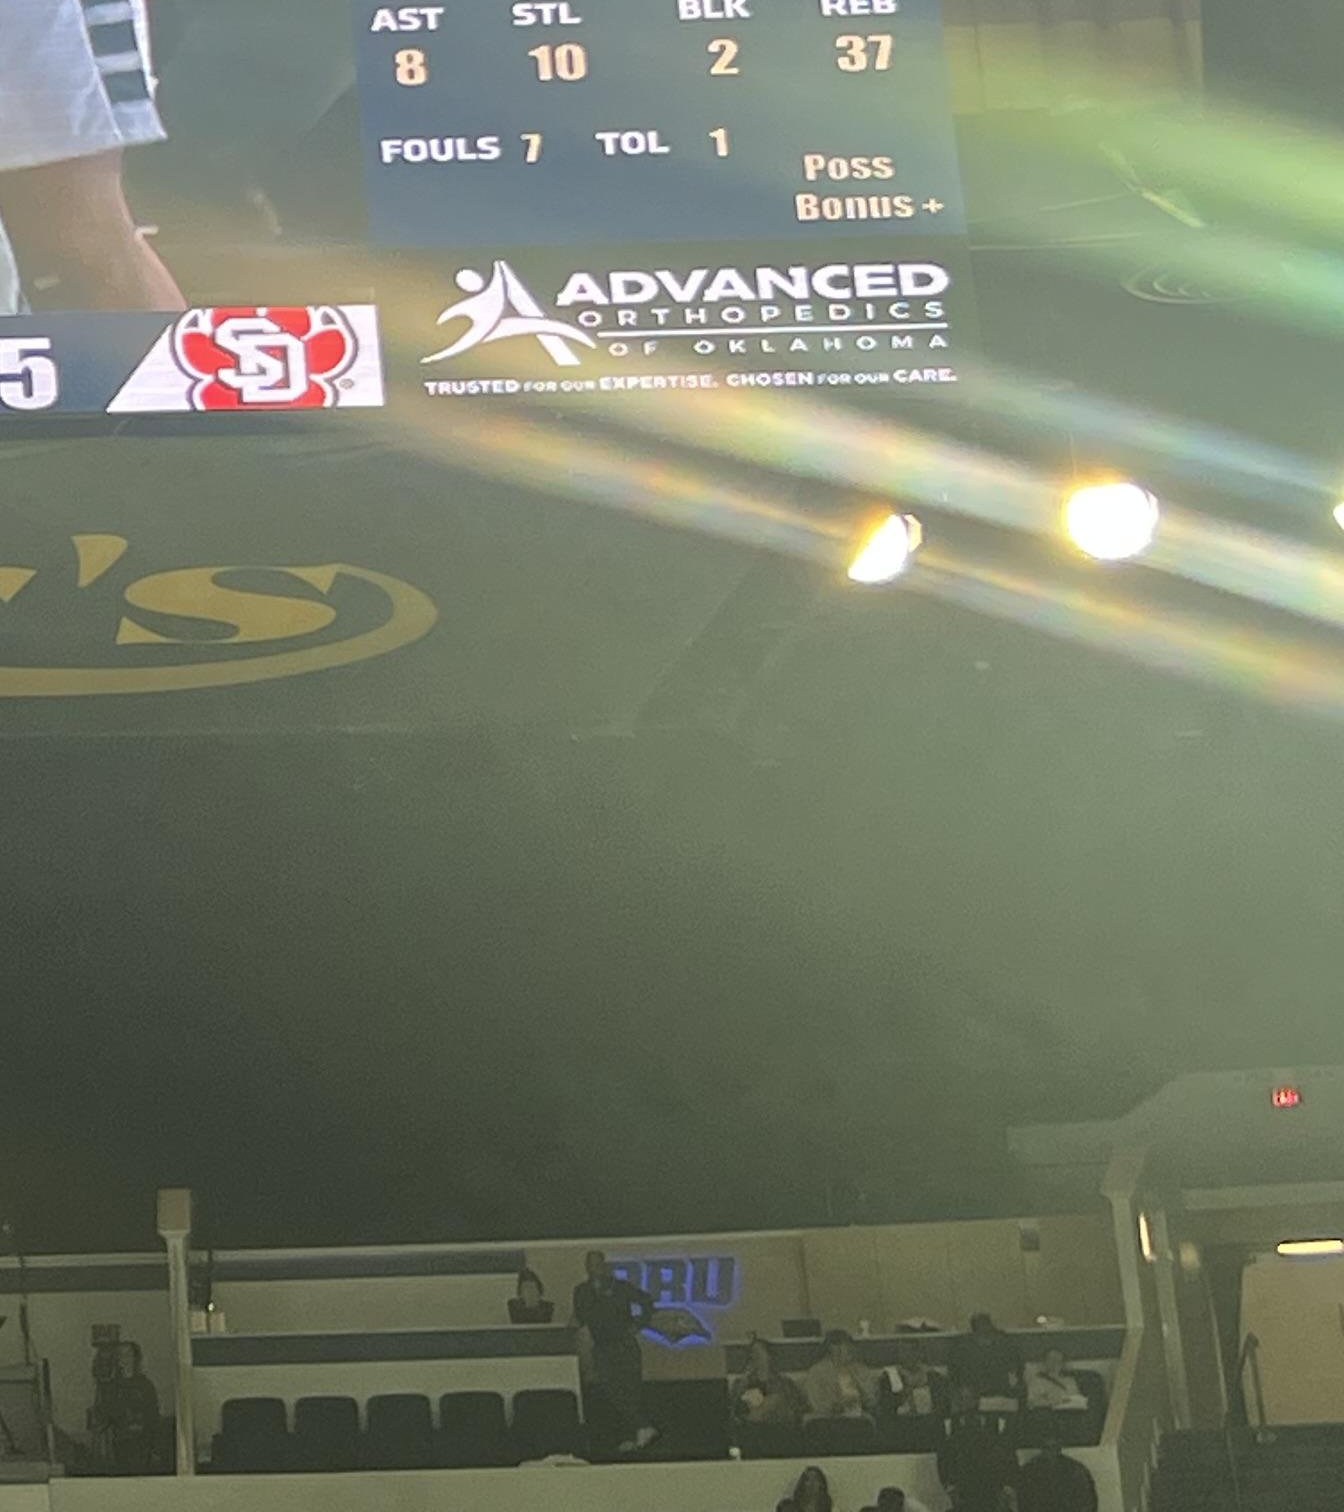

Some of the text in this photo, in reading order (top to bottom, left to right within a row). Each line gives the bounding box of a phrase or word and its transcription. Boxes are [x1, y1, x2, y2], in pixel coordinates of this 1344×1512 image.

[371, 8, 444, 31] AST
[512, 3, 581, 25] STL
[395, 34, 893, 87] 8 10 2 37
[381, 129, 729, 163] FOULS 7 TOL 1
[804, 155, 895, 181] Poss
[796, 193, 913, 221] Bonus
[556, 263, 949, 306] ADVANCED
[578, 301, 945, 328] ORTHOPEDICS
[694, 334, 947, 355] OKLAHOMA
